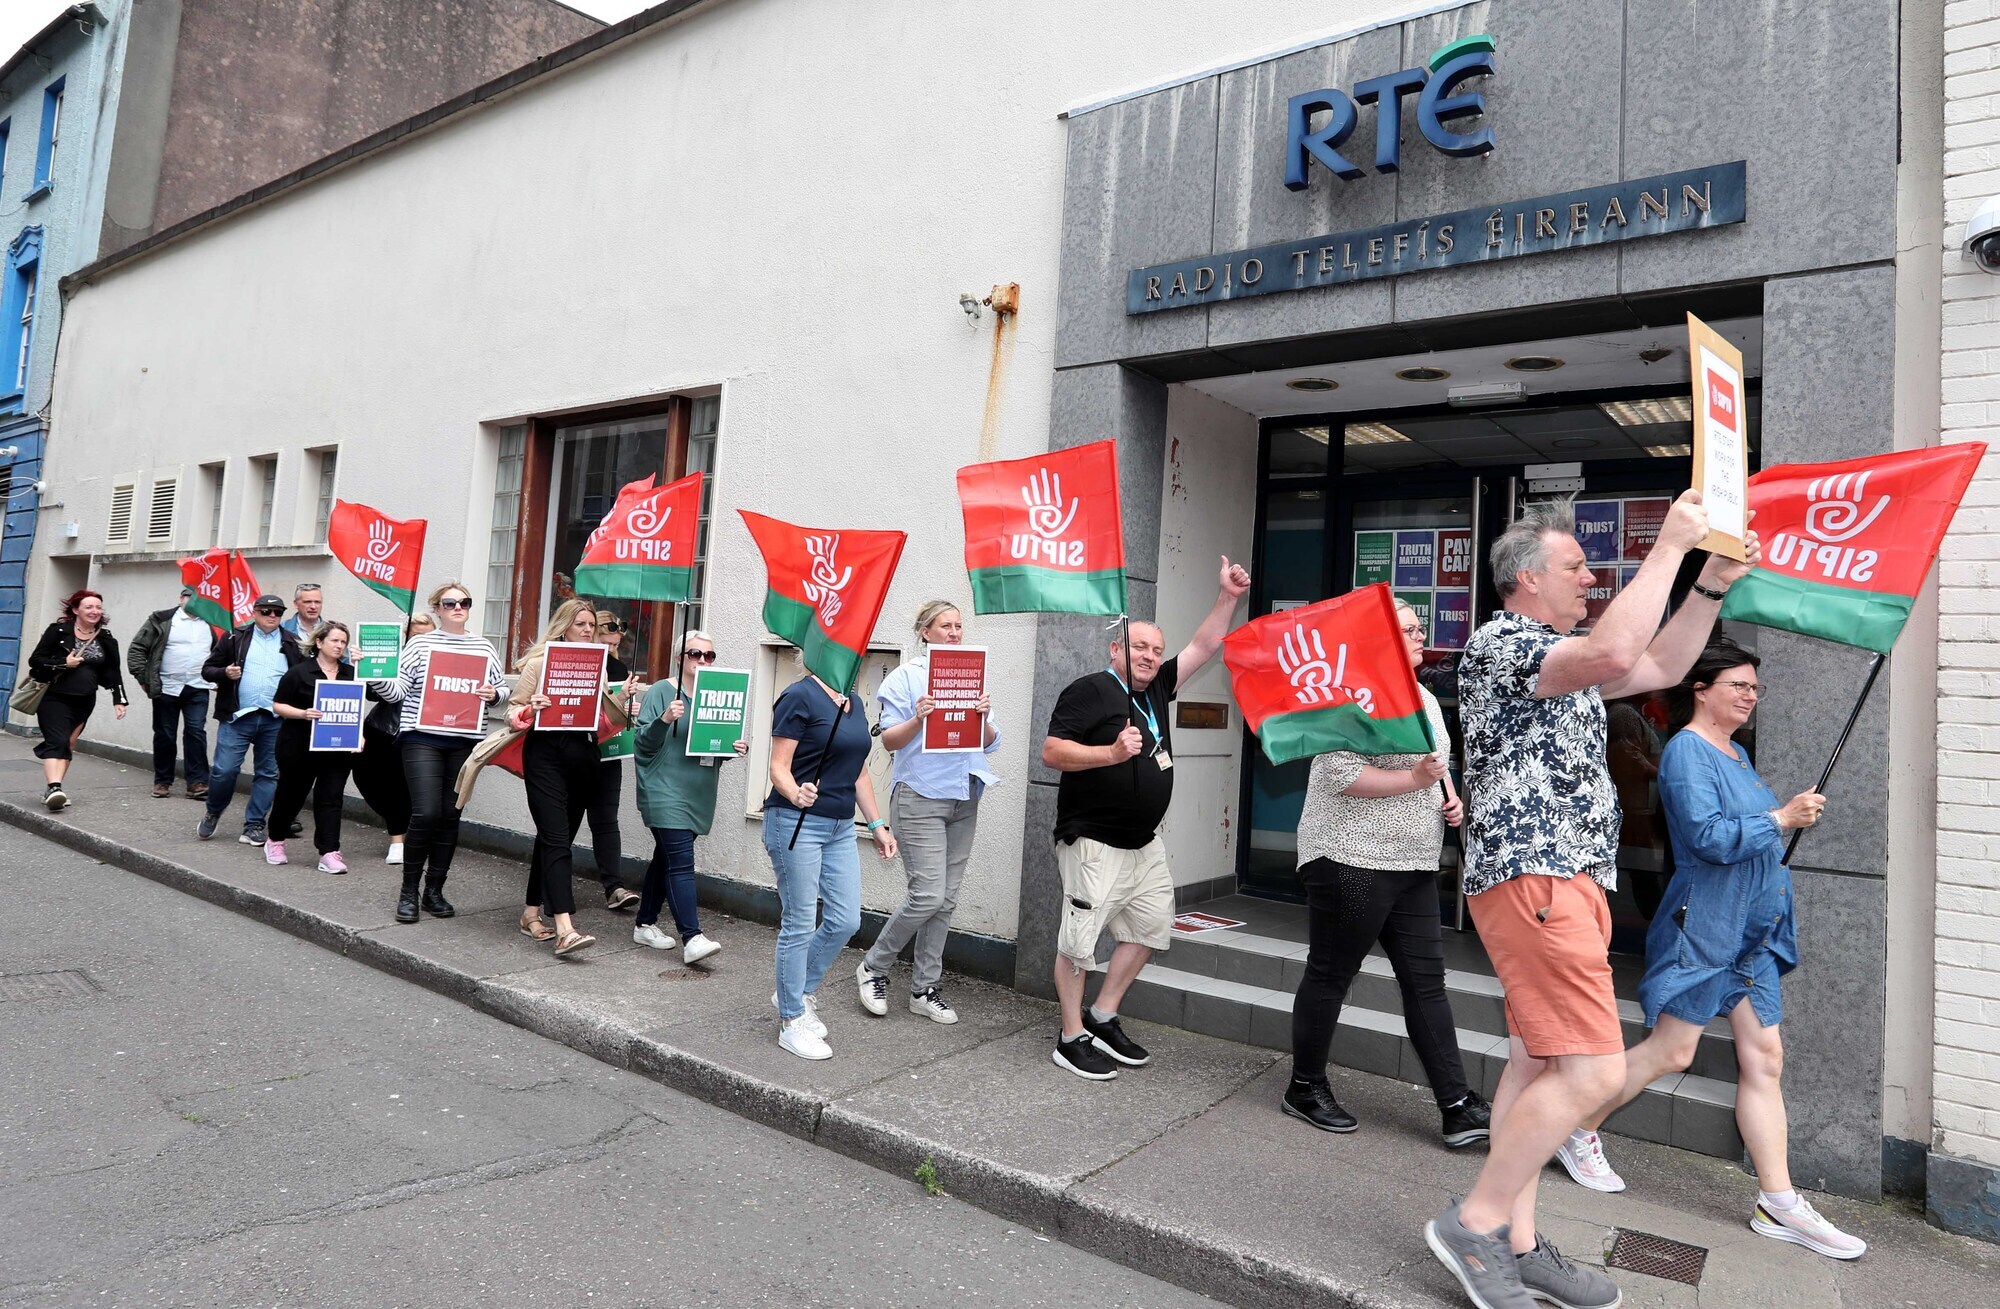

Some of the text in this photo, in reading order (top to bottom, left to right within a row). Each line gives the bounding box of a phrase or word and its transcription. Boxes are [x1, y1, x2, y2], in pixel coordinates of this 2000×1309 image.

[1283, 34, 1496, 192] RTÉ
[1145, 181, 1711, 301] RADIO TELEFÍS ÉIREANN
[1580, 521, 1615, 534] TRUST
[1400, 543, 1431, 556] TRUTH
[1444, 538, 1471, 555] PAY
[1399, 556, 1431, 565] MATTERS
[1585, 587, 1612, 599] RUST
[1439, 610, 1469, 622] TRUST
[550, 662, 600, 670] TRANSPARENCY
[933, 657, 982, 667] TRANSPARENCY
[549, 670, 598, 679] TRANSPARENCY
[933, 668, 982, 678] TRANSPARENCY
[433, 675, 480, 694] TRUST
[548, 679, 597, 687] TRANSPARENCY
[932, 679, 981, 688] TRANSPARENCY
[547, 687, 596, 696] TRANSPARENCY
[932, 689, 980, 699] TRANSPARENCY
[559, 696, 581, 706] AT RTÉ
[700, 689, 744, 708] TRUTH
[320, 698, 360, 713] TRUTH
[697, 707, 742, 721] MATTERS
[944, 711, 966, 721] AT RTÉ
